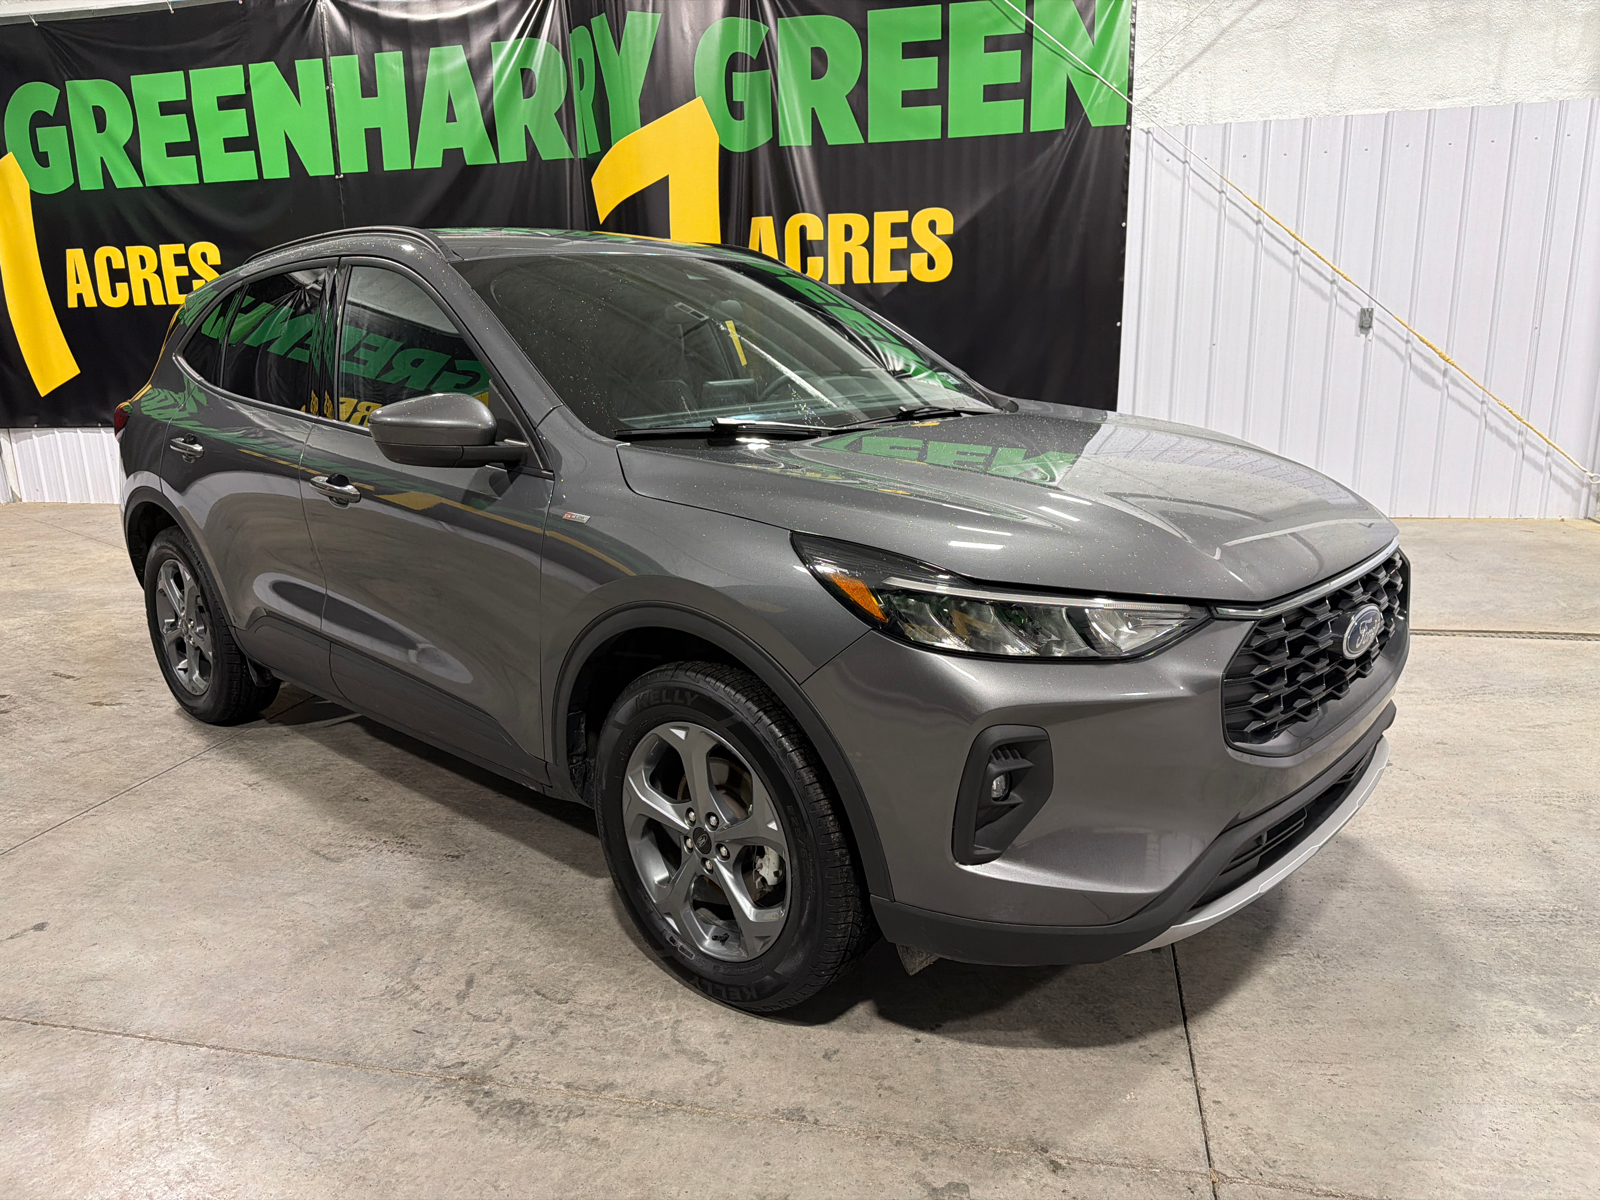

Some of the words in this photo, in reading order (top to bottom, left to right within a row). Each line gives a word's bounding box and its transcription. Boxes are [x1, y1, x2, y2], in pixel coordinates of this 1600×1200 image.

[693, 0, 1129, 153] GREEN
[66, 241, 222, 308] ACRES
[748, 207, 955, 285] ACRES
[636, 687, 699, 711] KELLY
